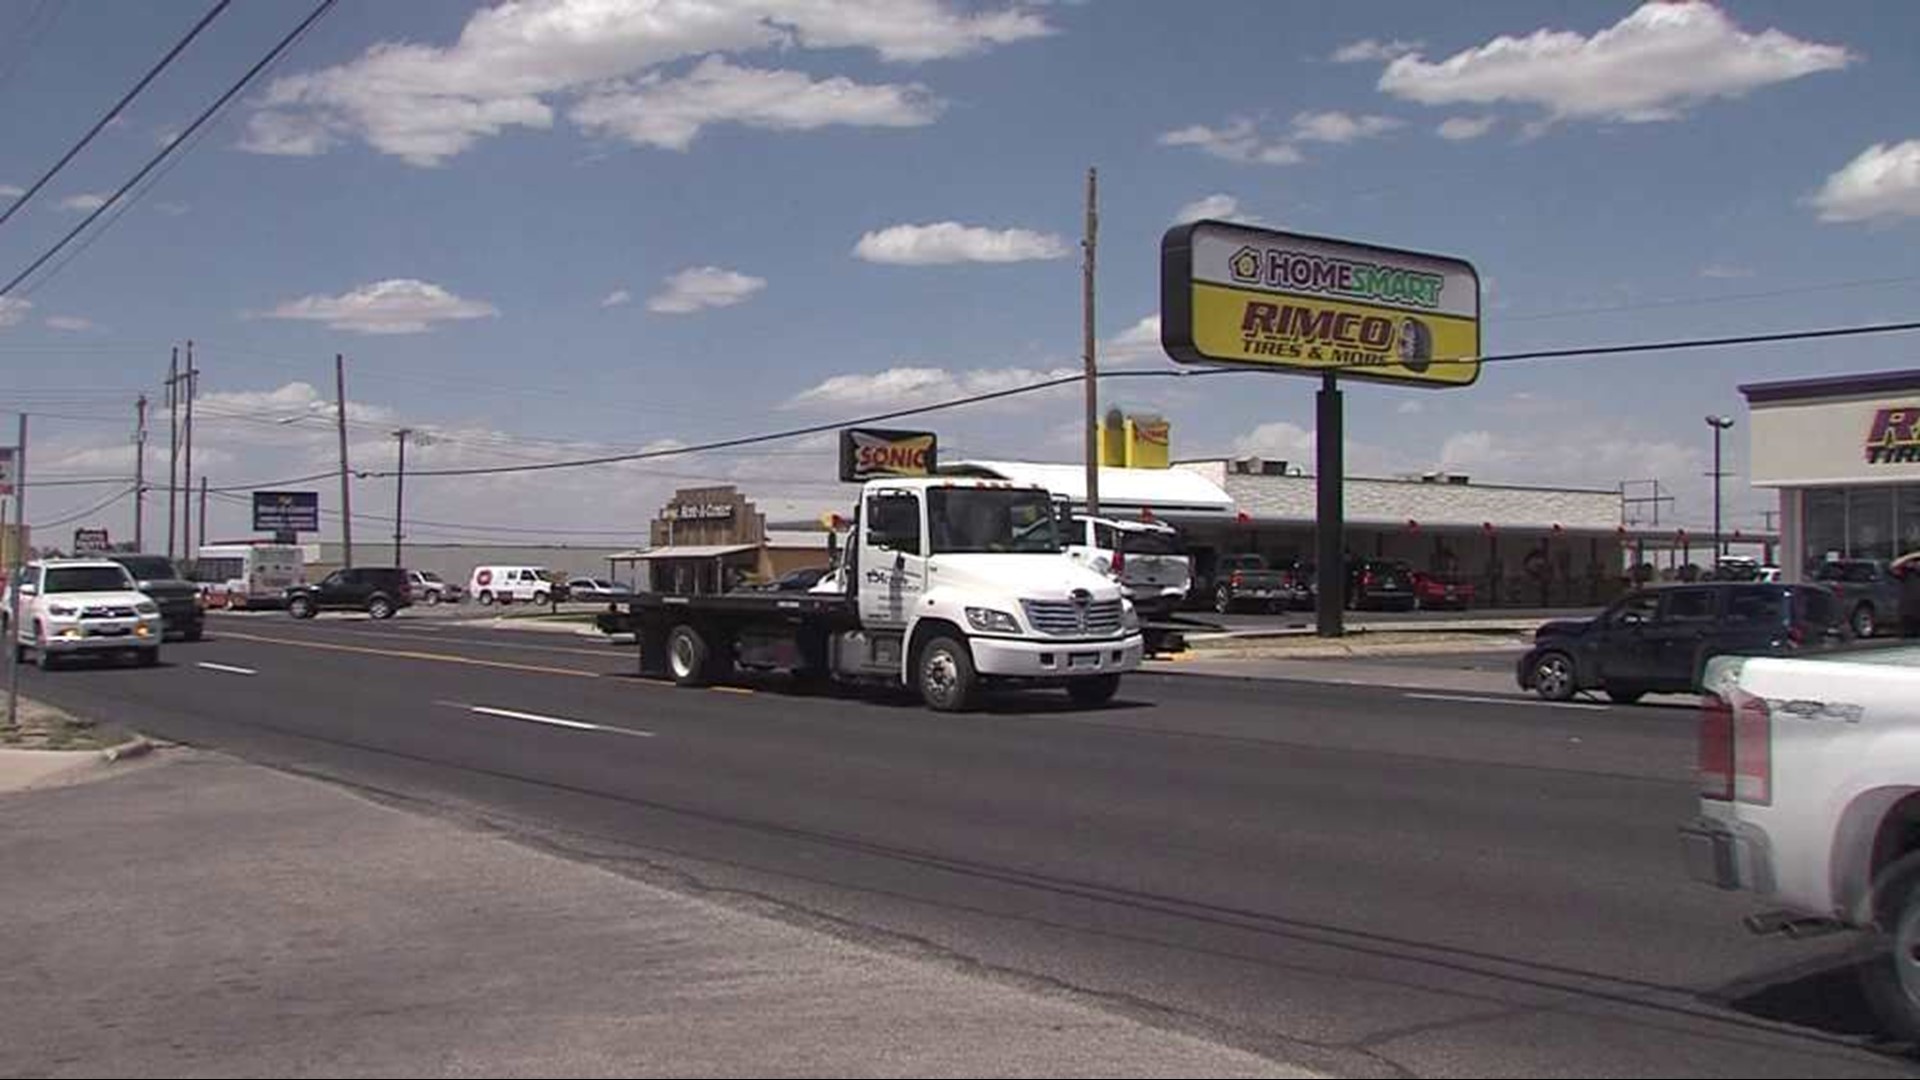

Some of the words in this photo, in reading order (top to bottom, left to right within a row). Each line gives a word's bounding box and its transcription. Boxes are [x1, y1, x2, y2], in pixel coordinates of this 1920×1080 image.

[1268, 251, 1442, 306] HOMESMART
[1241, 301, 1394, 351] RIMCO
[1243, 340, 1301, 358] TIRES
[1307, 347, 1323, 360] &
[860, 446, 925, 469] SONIC
